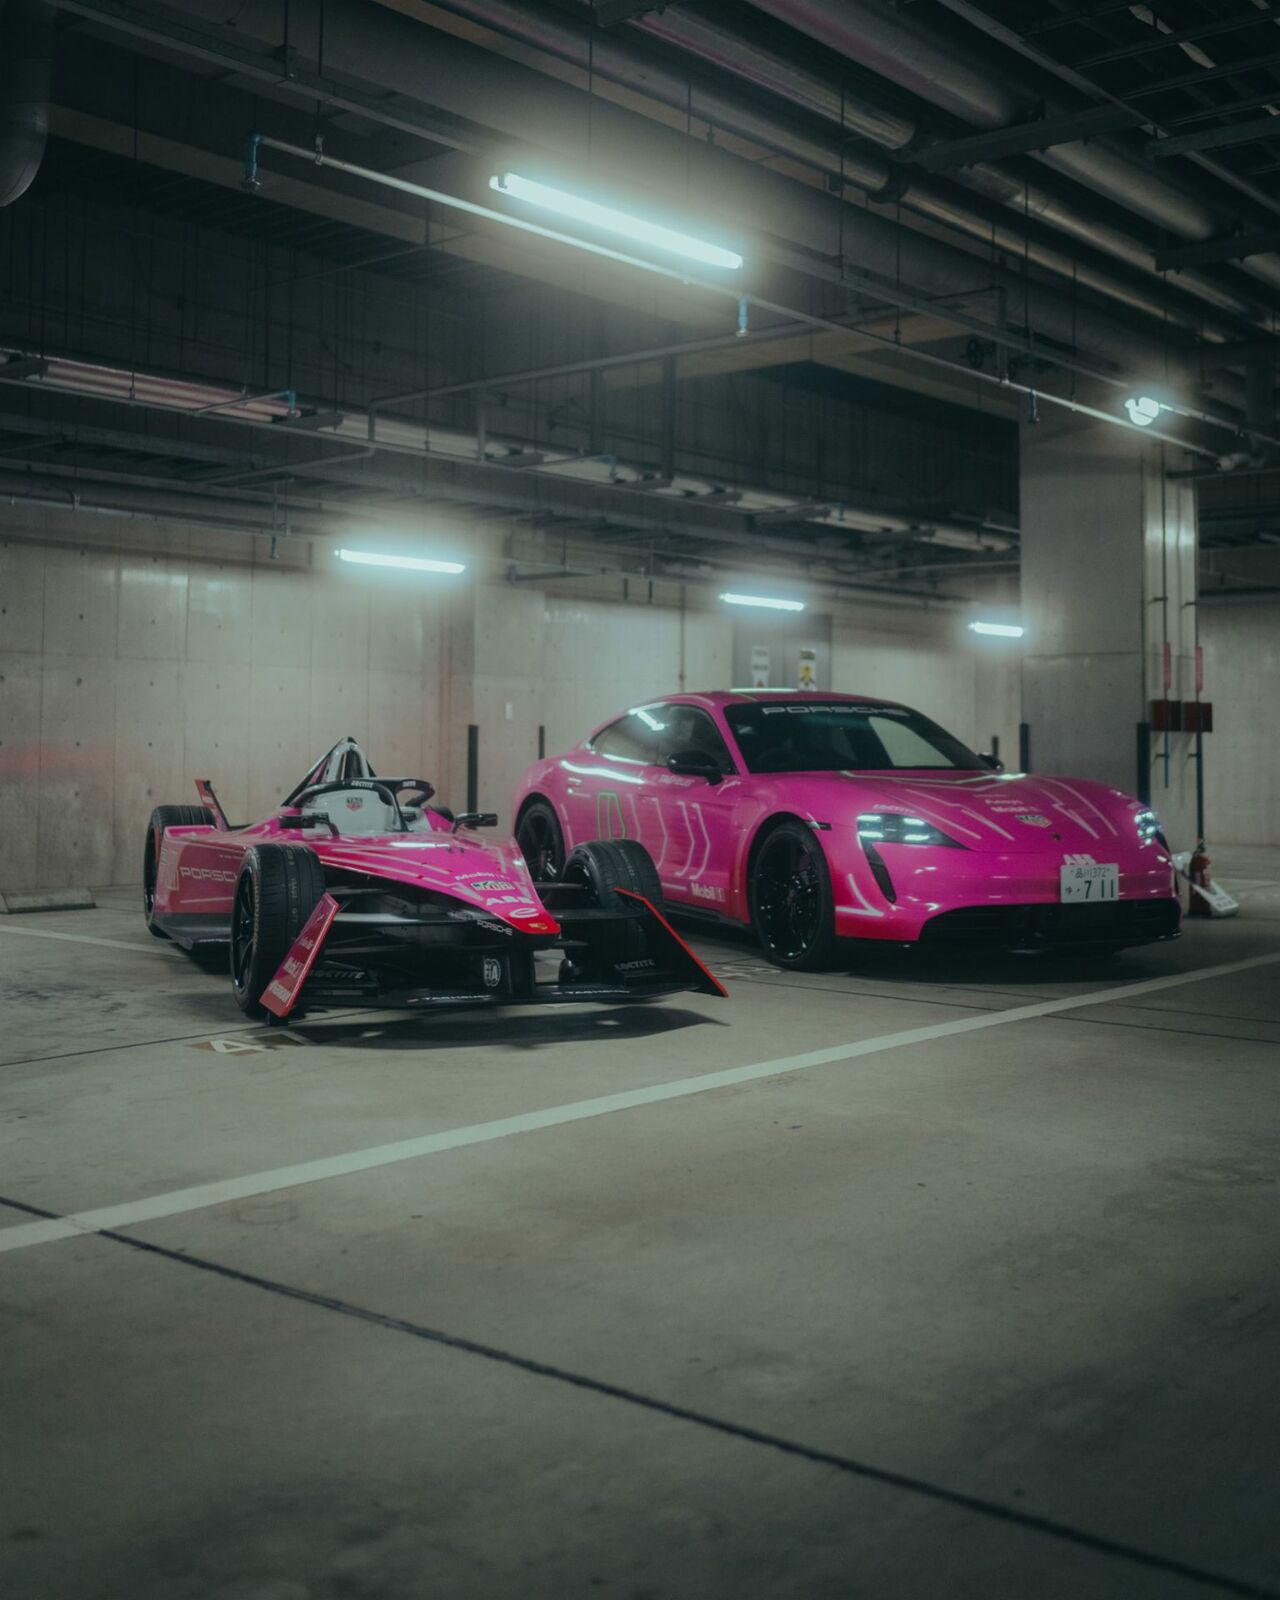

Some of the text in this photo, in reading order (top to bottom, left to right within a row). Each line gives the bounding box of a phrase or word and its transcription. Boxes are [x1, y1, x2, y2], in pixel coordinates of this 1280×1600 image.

[762, 706, 909, 717] PORSCHE
[180, 867, 238, 882] PORSC
[477, 919, 513, 936] PORSCHE
